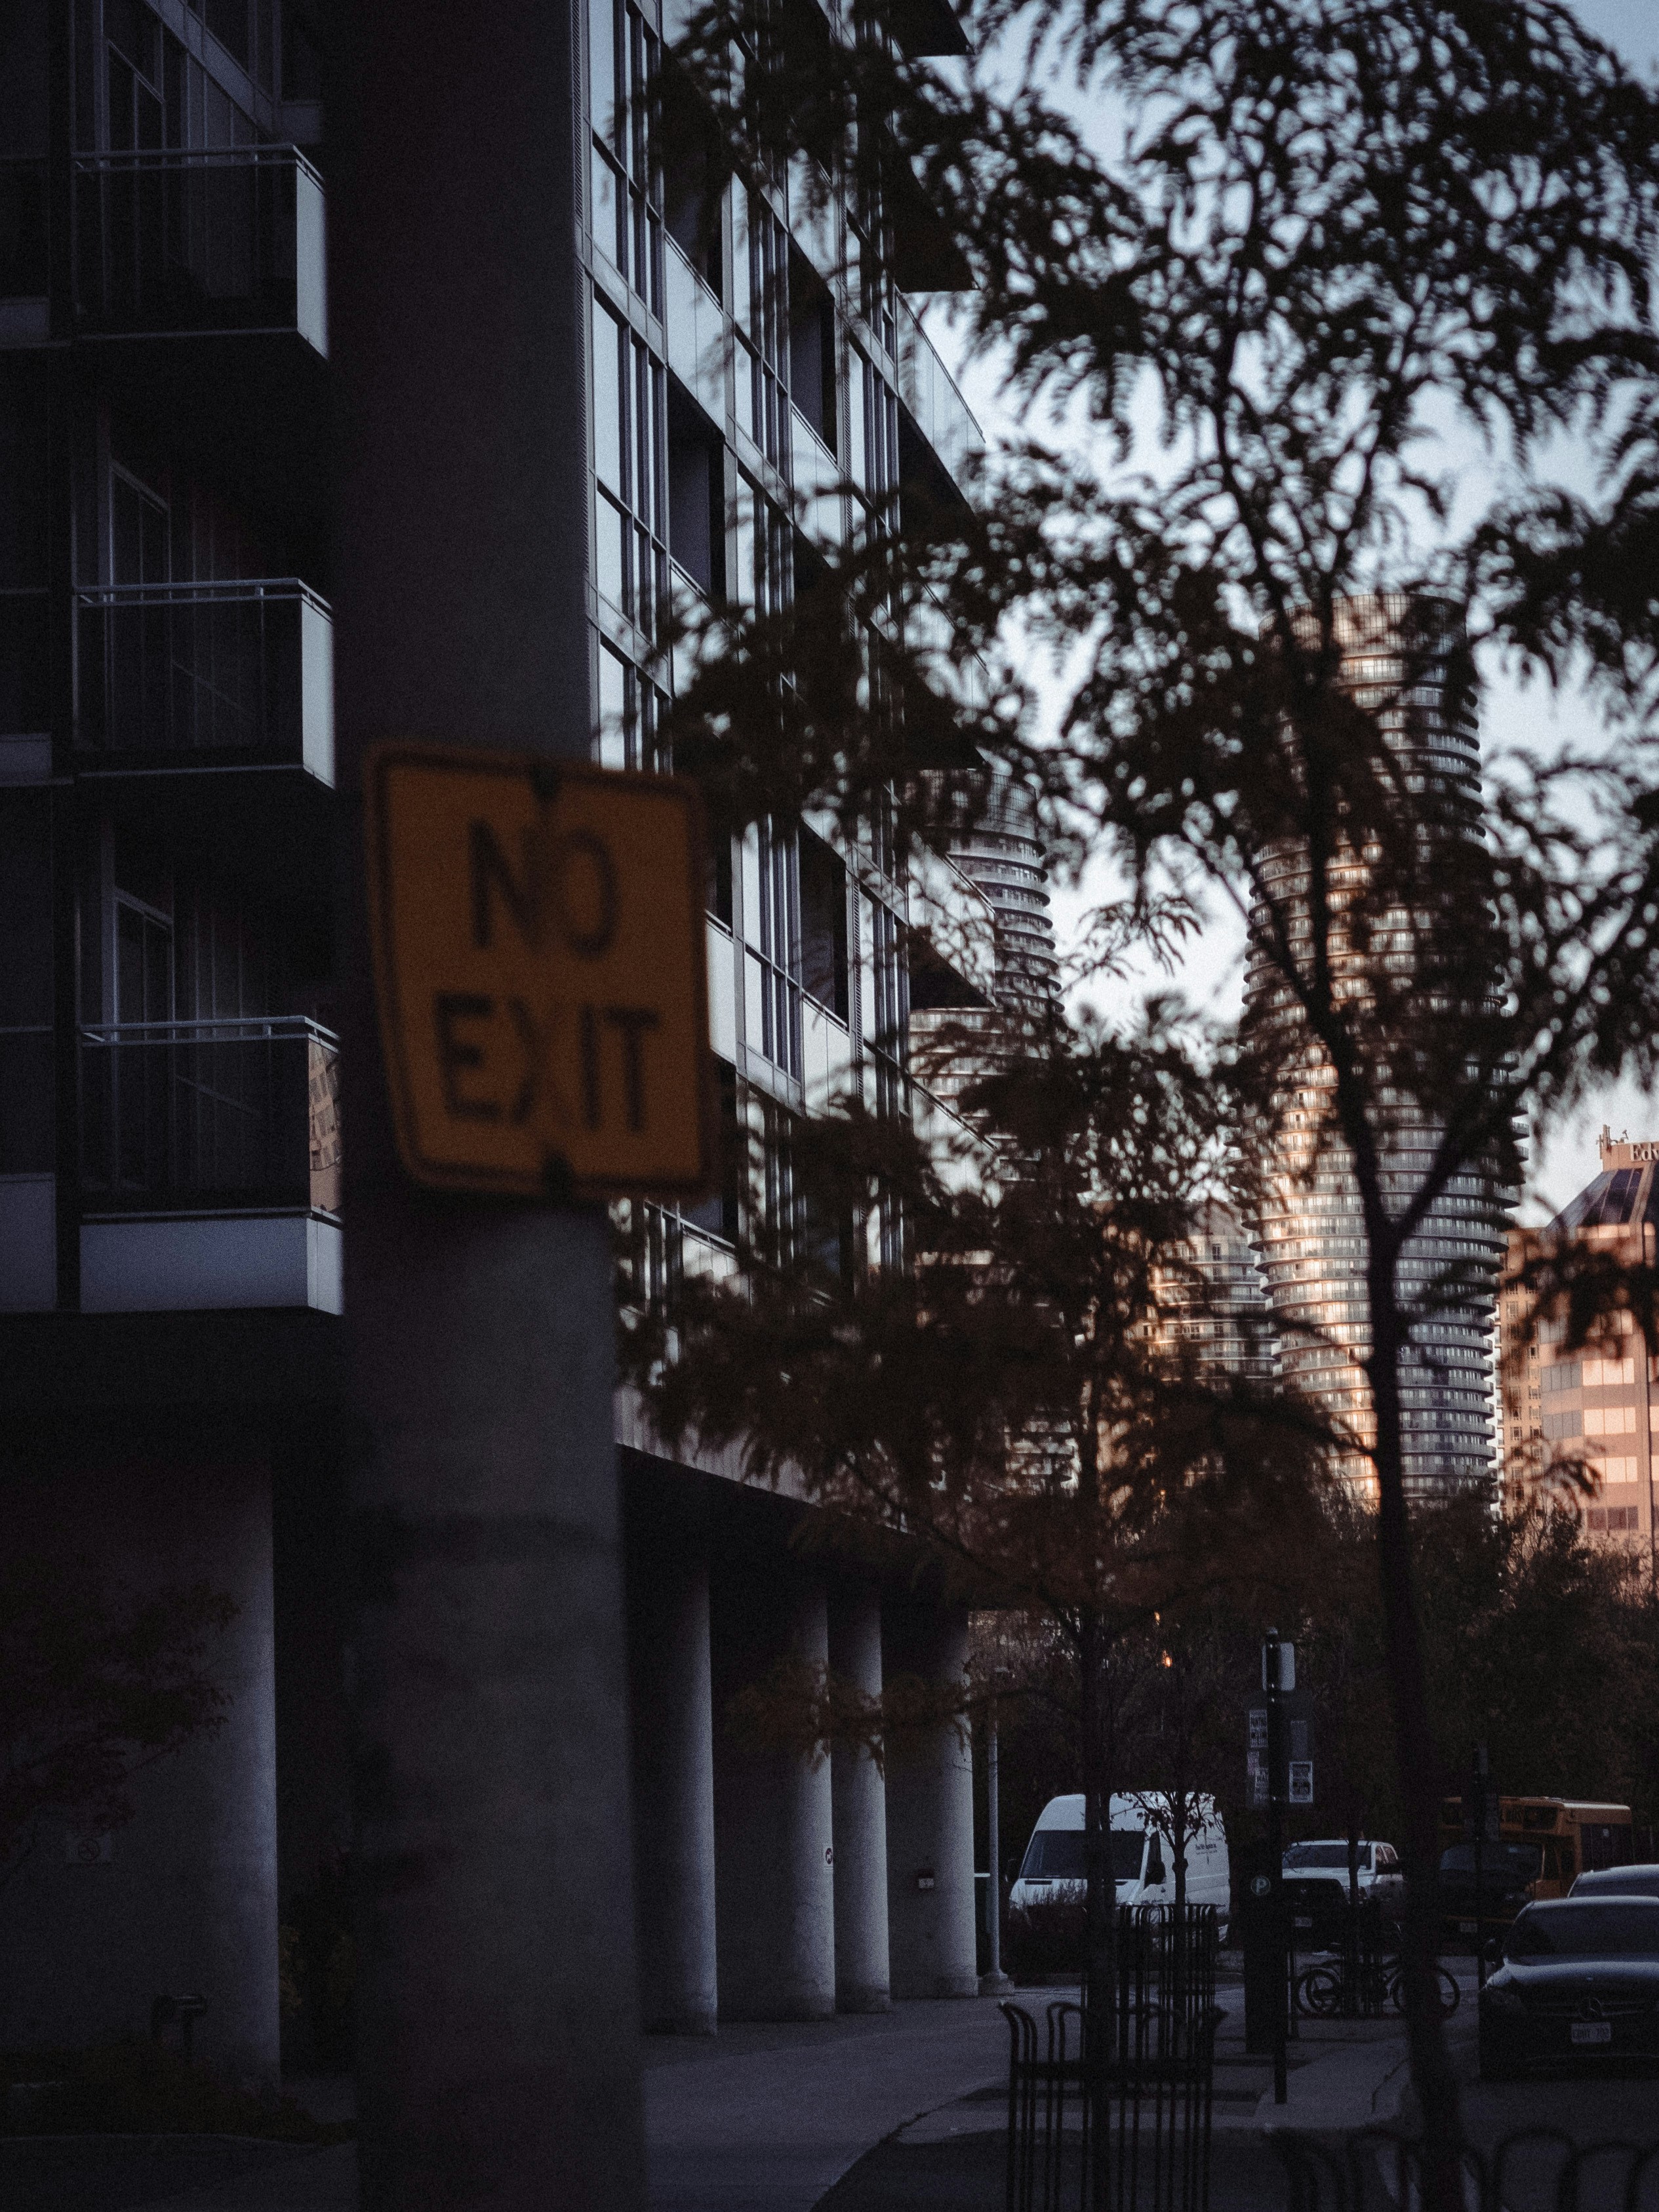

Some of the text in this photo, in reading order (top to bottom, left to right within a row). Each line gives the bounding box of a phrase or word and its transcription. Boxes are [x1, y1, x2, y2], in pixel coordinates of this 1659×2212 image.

[468, 818, 621, 959] NO
[434, 990, 660, 1133] EXIT
[1256, 1878, 1267, 1893] P
